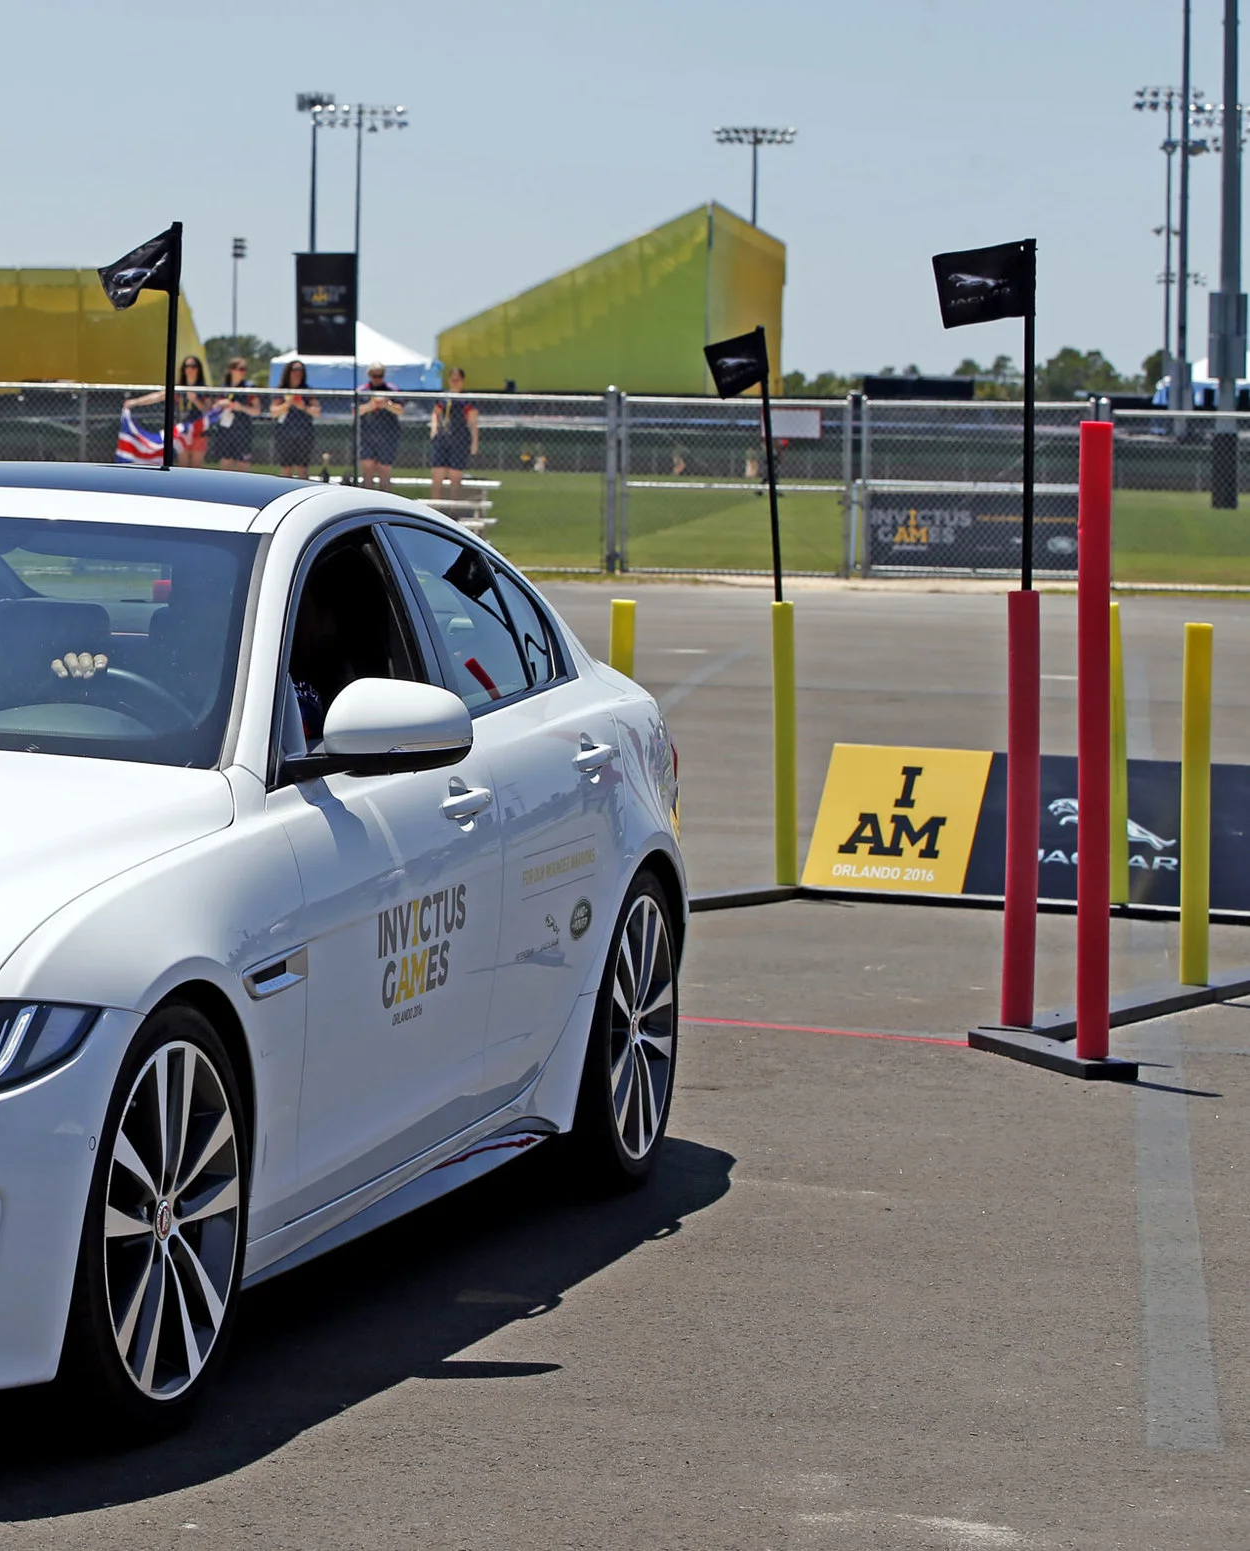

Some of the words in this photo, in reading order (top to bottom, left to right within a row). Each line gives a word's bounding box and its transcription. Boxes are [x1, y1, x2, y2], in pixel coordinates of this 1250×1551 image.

[871, 509, 971, 527] INVICTUS
[877, 526, 956, 543] GAMES
[894, 766, 923, 808] I
[837, 812, 947, 859] AM
[831, 863, 901, 880] ORLANDO
[903, 867, 935, 882] 2016
[1037, 848, 1179, 871] JAAR
[377, 883, 467, 960] INVICTUS
[381, 940, 451, 1009] GAMES
